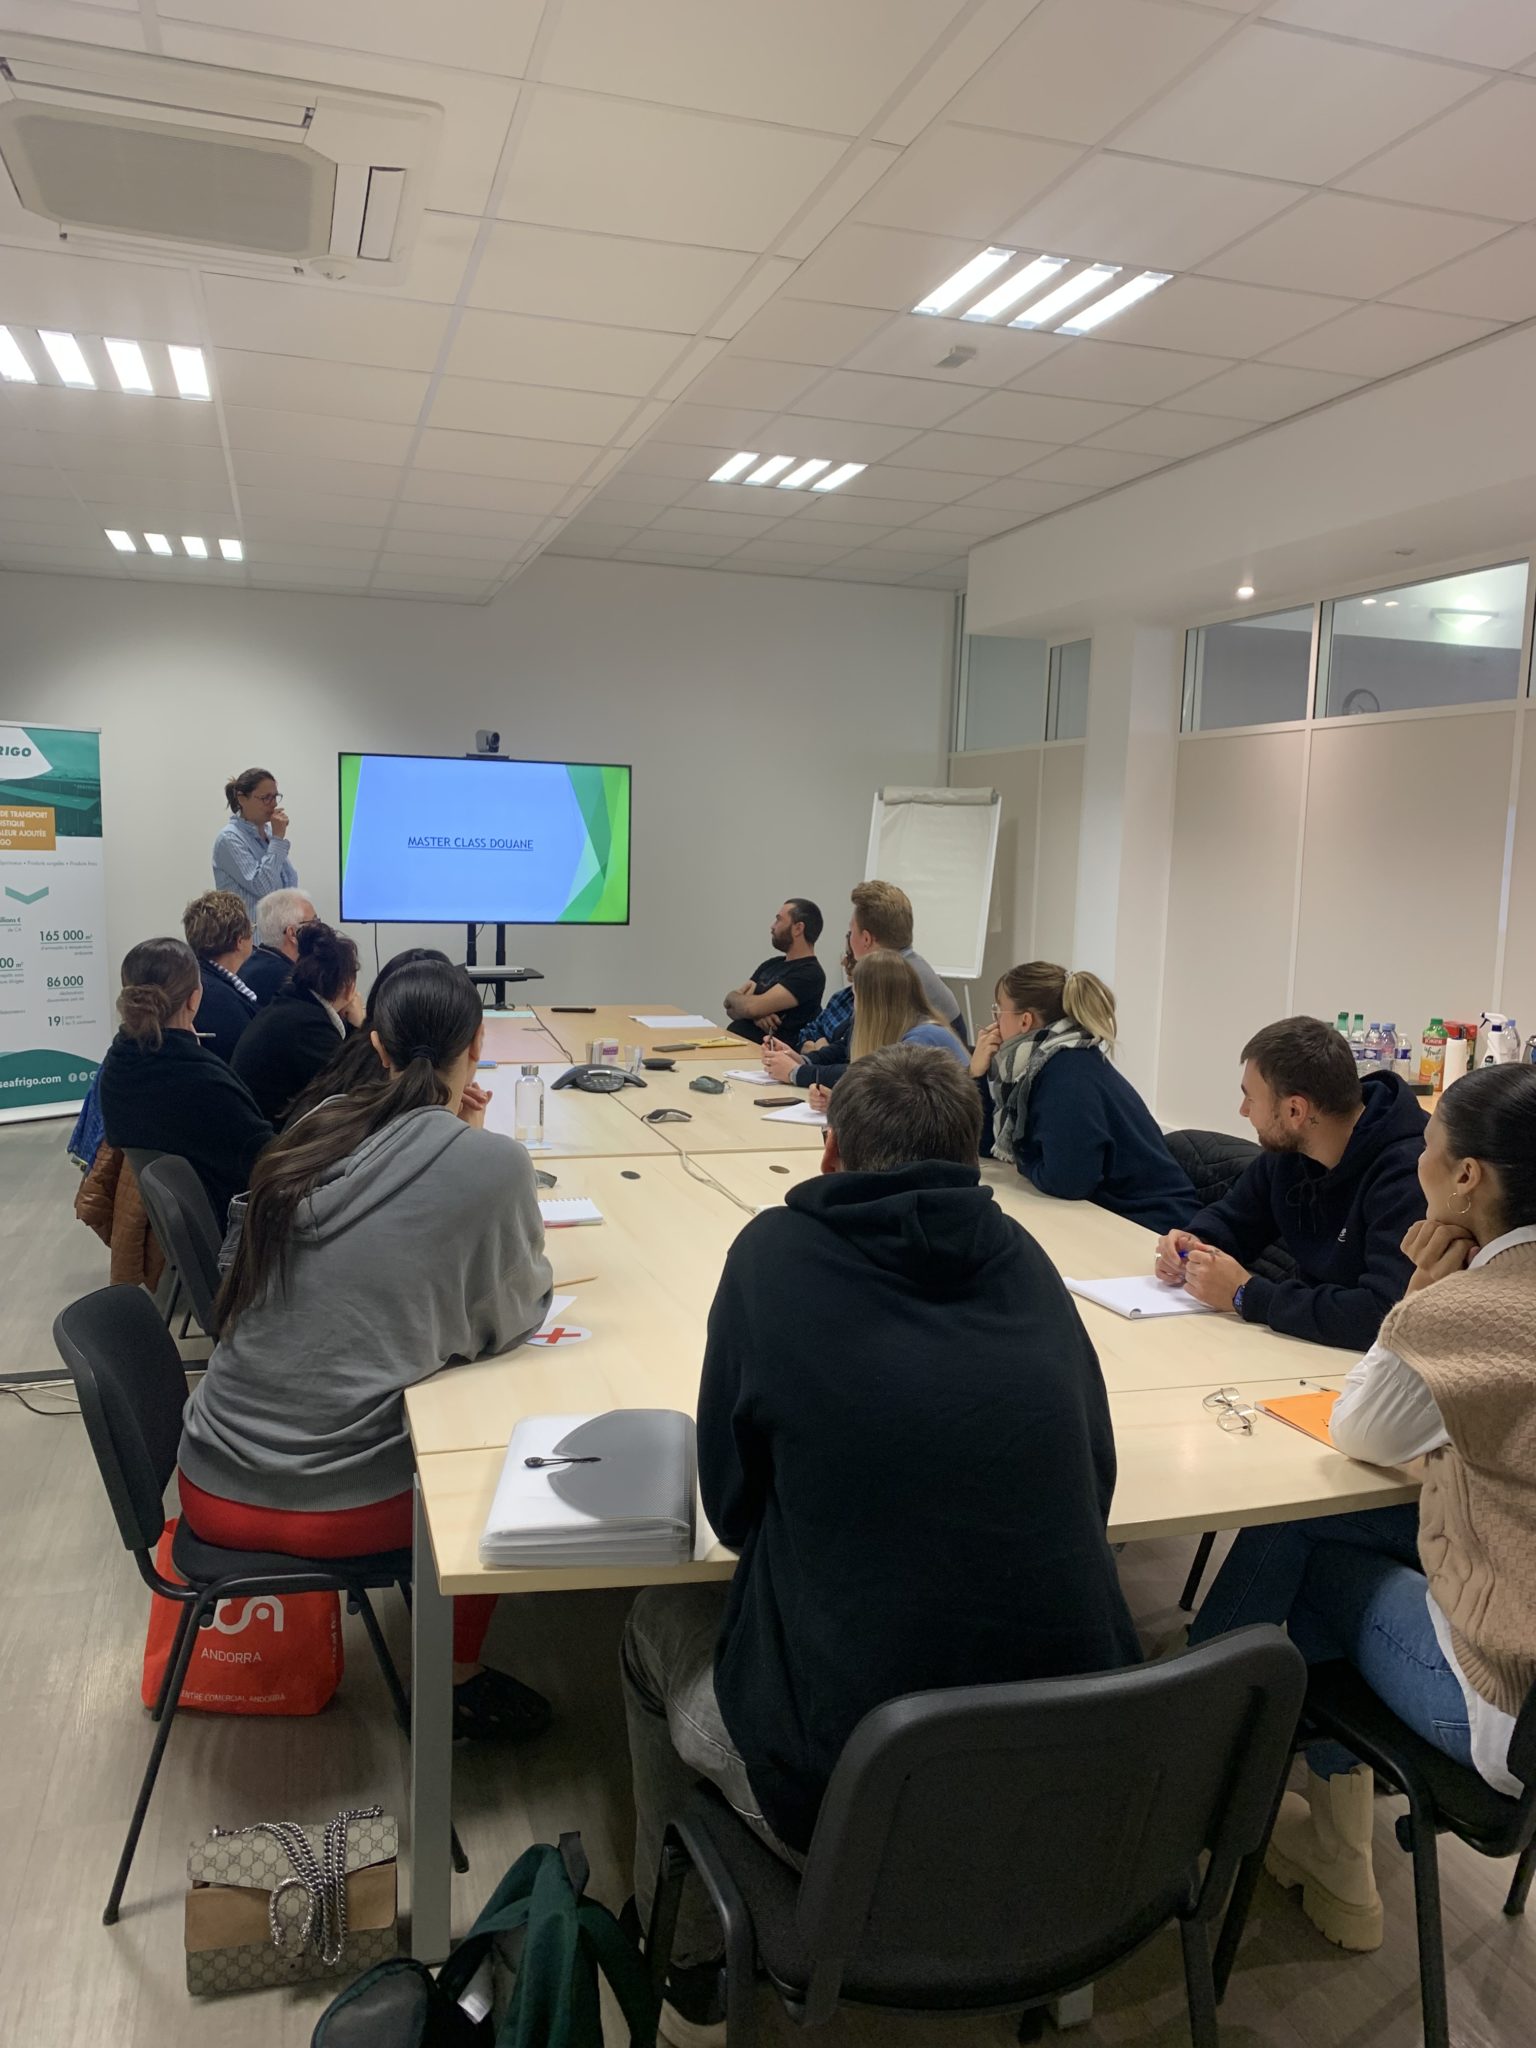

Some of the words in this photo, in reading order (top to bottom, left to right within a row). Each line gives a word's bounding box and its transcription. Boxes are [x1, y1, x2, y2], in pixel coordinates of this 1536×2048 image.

[407, 836, 451, 847] MASTER
[454, 837, 487, 848] CLASS
[490, 839, 534, 849] DOUANE
[40, 930, 60, 942] 165
[63, 929, 84, 941] 000
[47, 976, 61, 988] 86
[63, 975, 84, 987] 000
[48, 1015, 61, 1027] 19
[200, 1647, 263, 1664] ANDORRA
[180, 1689, 204, 1702] ENTRE
